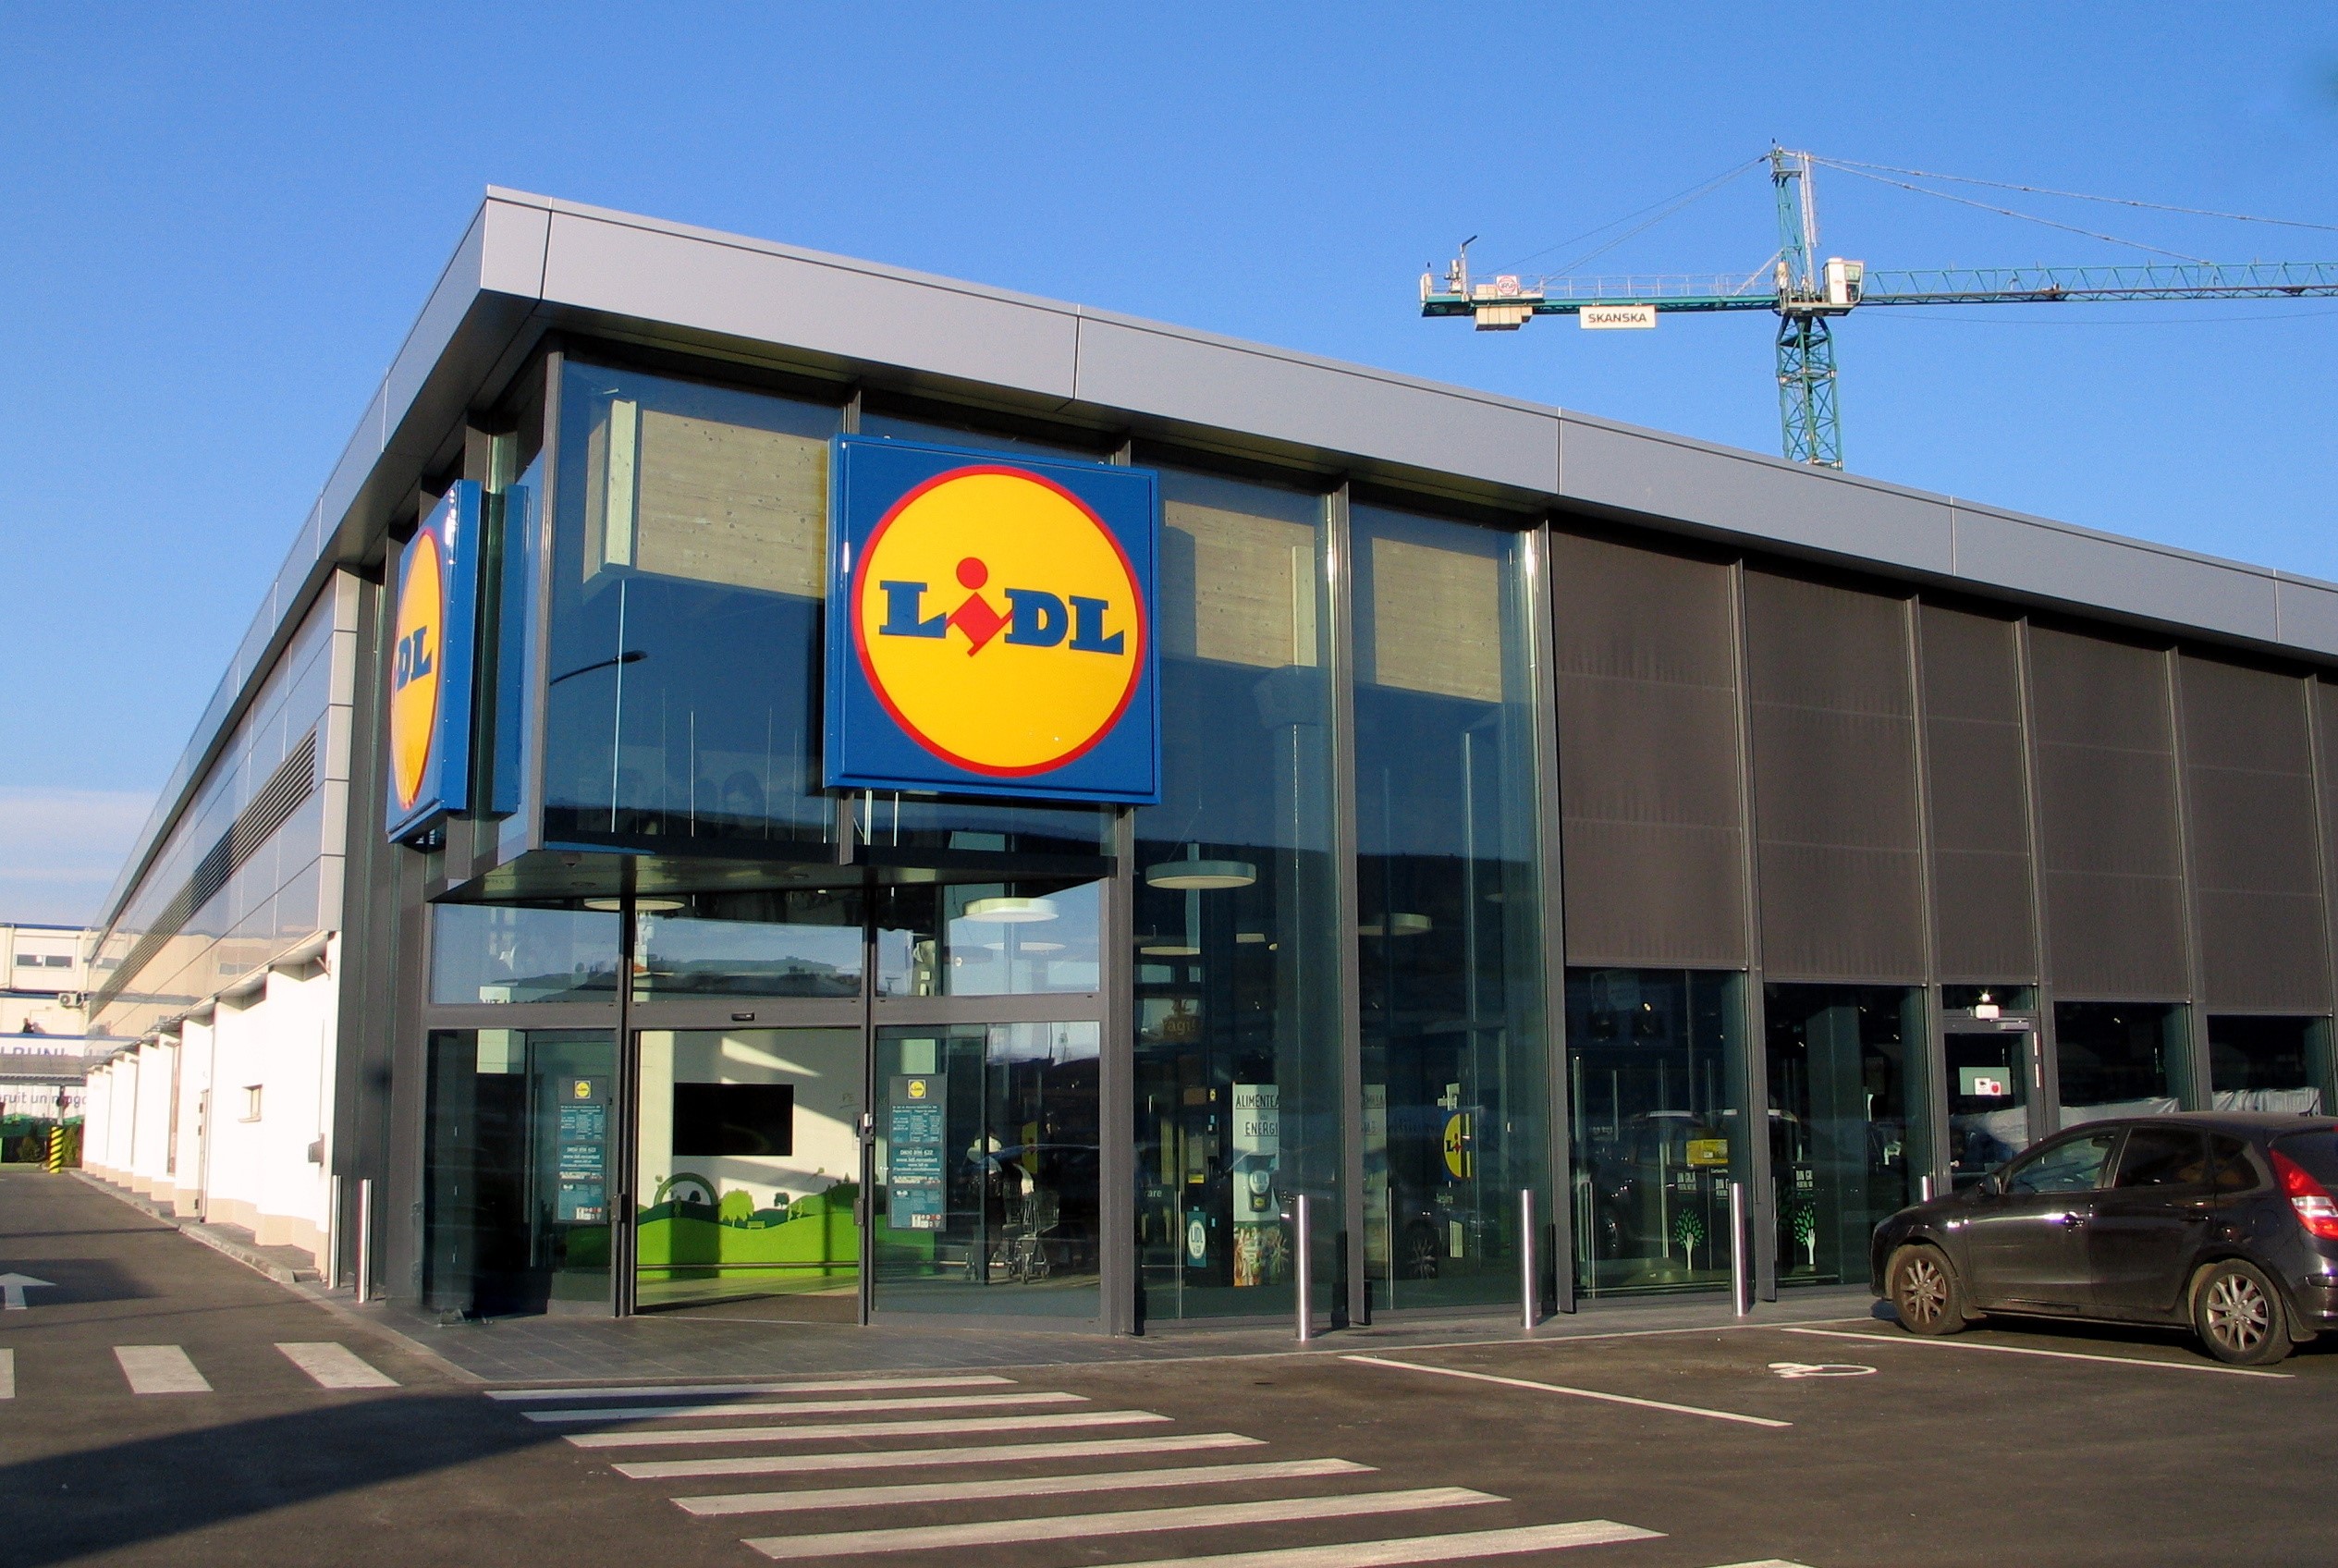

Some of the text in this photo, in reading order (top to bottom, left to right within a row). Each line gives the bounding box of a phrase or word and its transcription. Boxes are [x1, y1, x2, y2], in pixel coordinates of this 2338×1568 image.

[1587, 312, 1647, 324] SKANSKA
[0, 1092, 29, 1105] ruit
[31, 1095, 47, 1104] un
